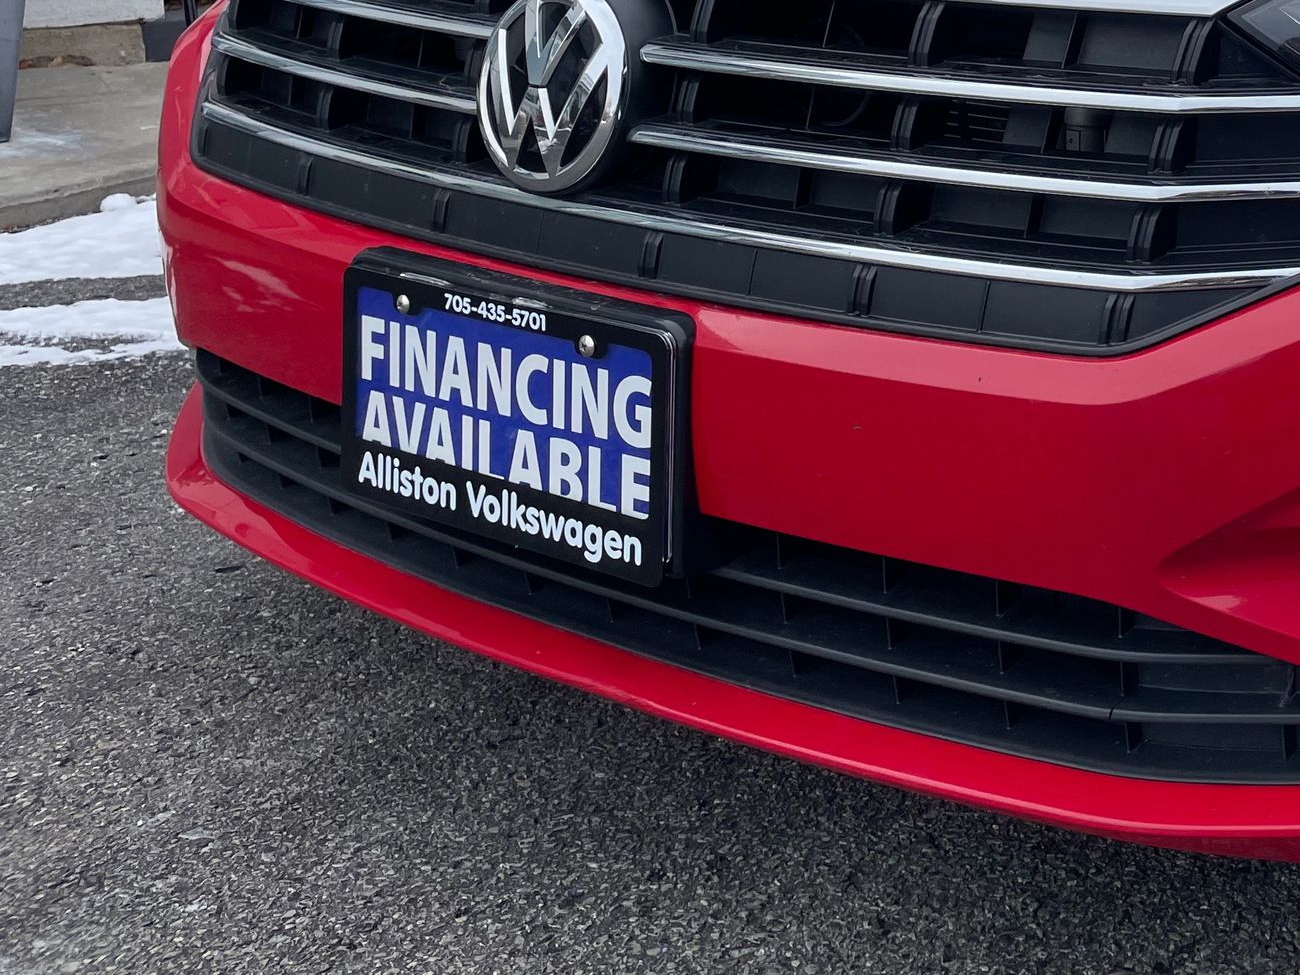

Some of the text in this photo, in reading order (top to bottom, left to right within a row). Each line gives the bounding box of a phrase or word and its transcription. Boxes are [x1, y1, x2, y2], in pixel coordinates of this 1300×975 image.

[444, 292, 546, 332] 705-435-5701
[361, 314, 653, 449] FINANCING
[358, 451, 642, 566] Alliston Volkswagen
[362, 389, 651, 520] AVAILABLE
